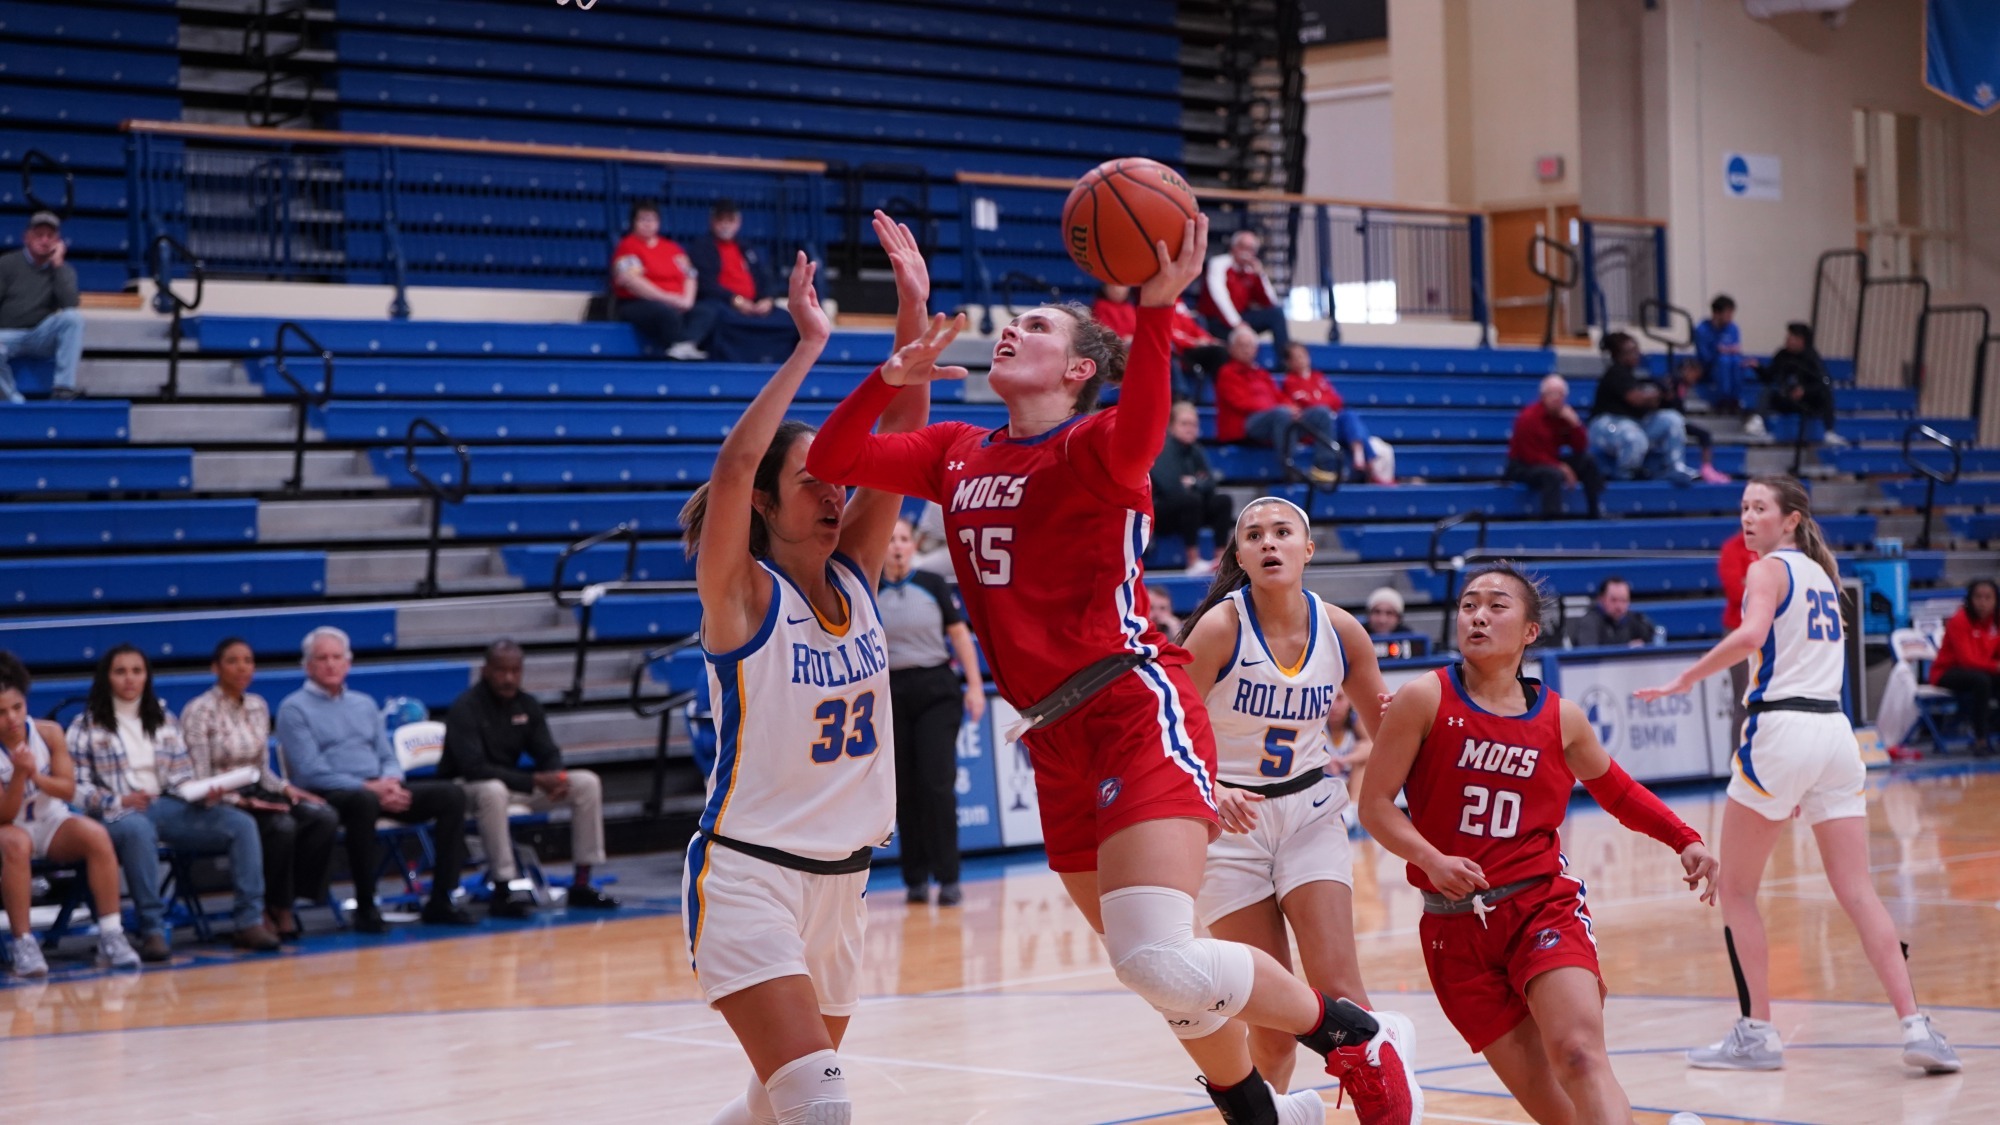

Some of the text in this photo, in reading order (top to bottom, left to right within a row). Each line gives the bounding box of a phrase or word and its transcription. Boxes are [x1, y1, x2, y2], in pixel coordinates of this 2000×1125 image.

[949, 474, 1029, 513] MOCS
[1805, 587, 1842, 643] 25
[791, 627, 886, 688] ROLLINS
[1232, 677, 1334, 721] ROLLINS
[810, 688, 881, 767] 33
[1257, 724, 1300, 778] 5
[1628, 723, 1678, 751] BMW
[1457, 738, 1539, 778] MOCS
[1458, 784, 1523, 839] 20
